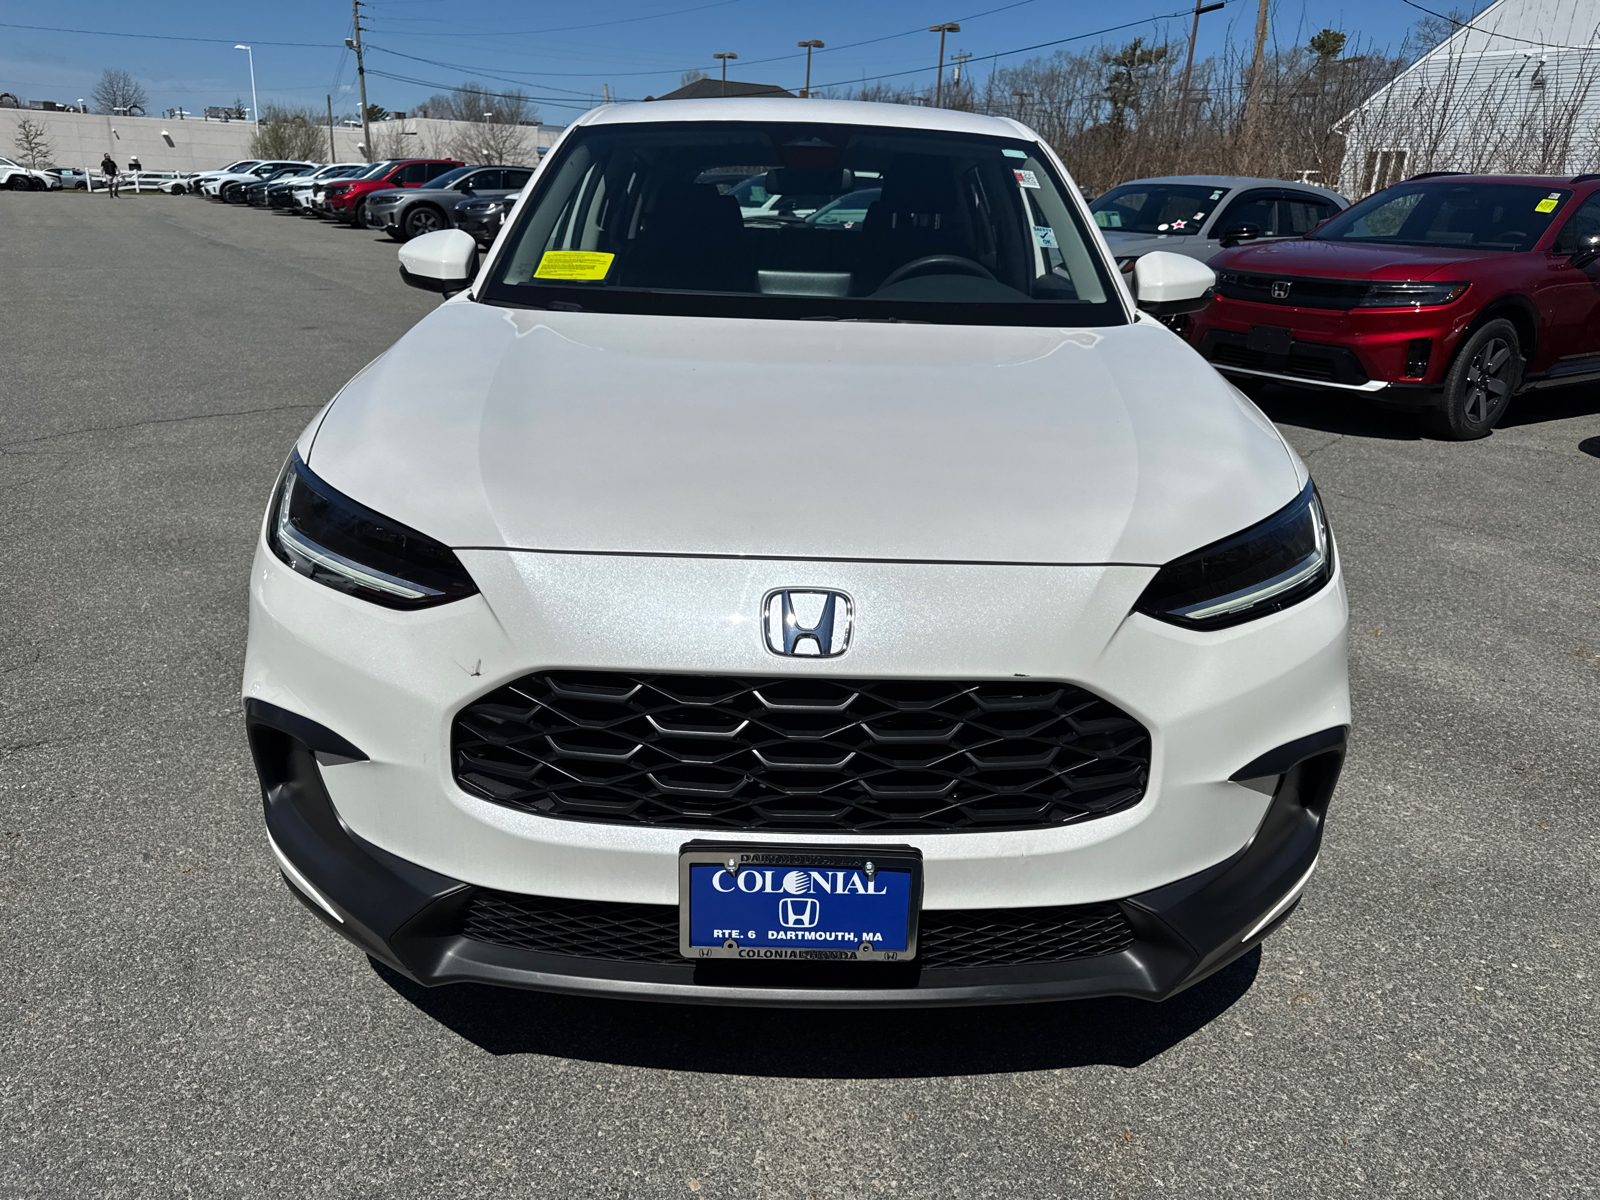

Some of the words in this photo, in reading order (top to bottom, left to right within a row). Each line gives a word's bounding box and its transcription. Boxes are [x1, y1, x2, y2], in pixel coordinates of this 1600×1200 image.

[712, 869, 887, 895] COLONIAL
[713, 929, 745, 938] RTE.
[747, 929, 757, 939] 6
[768, 930, 858, 943] DARTMOUTH,
[862, 931, 883, 942] MA
[737, 948, 804, 959] COLONIAL
[808, 949, 859, 960] HONDA
